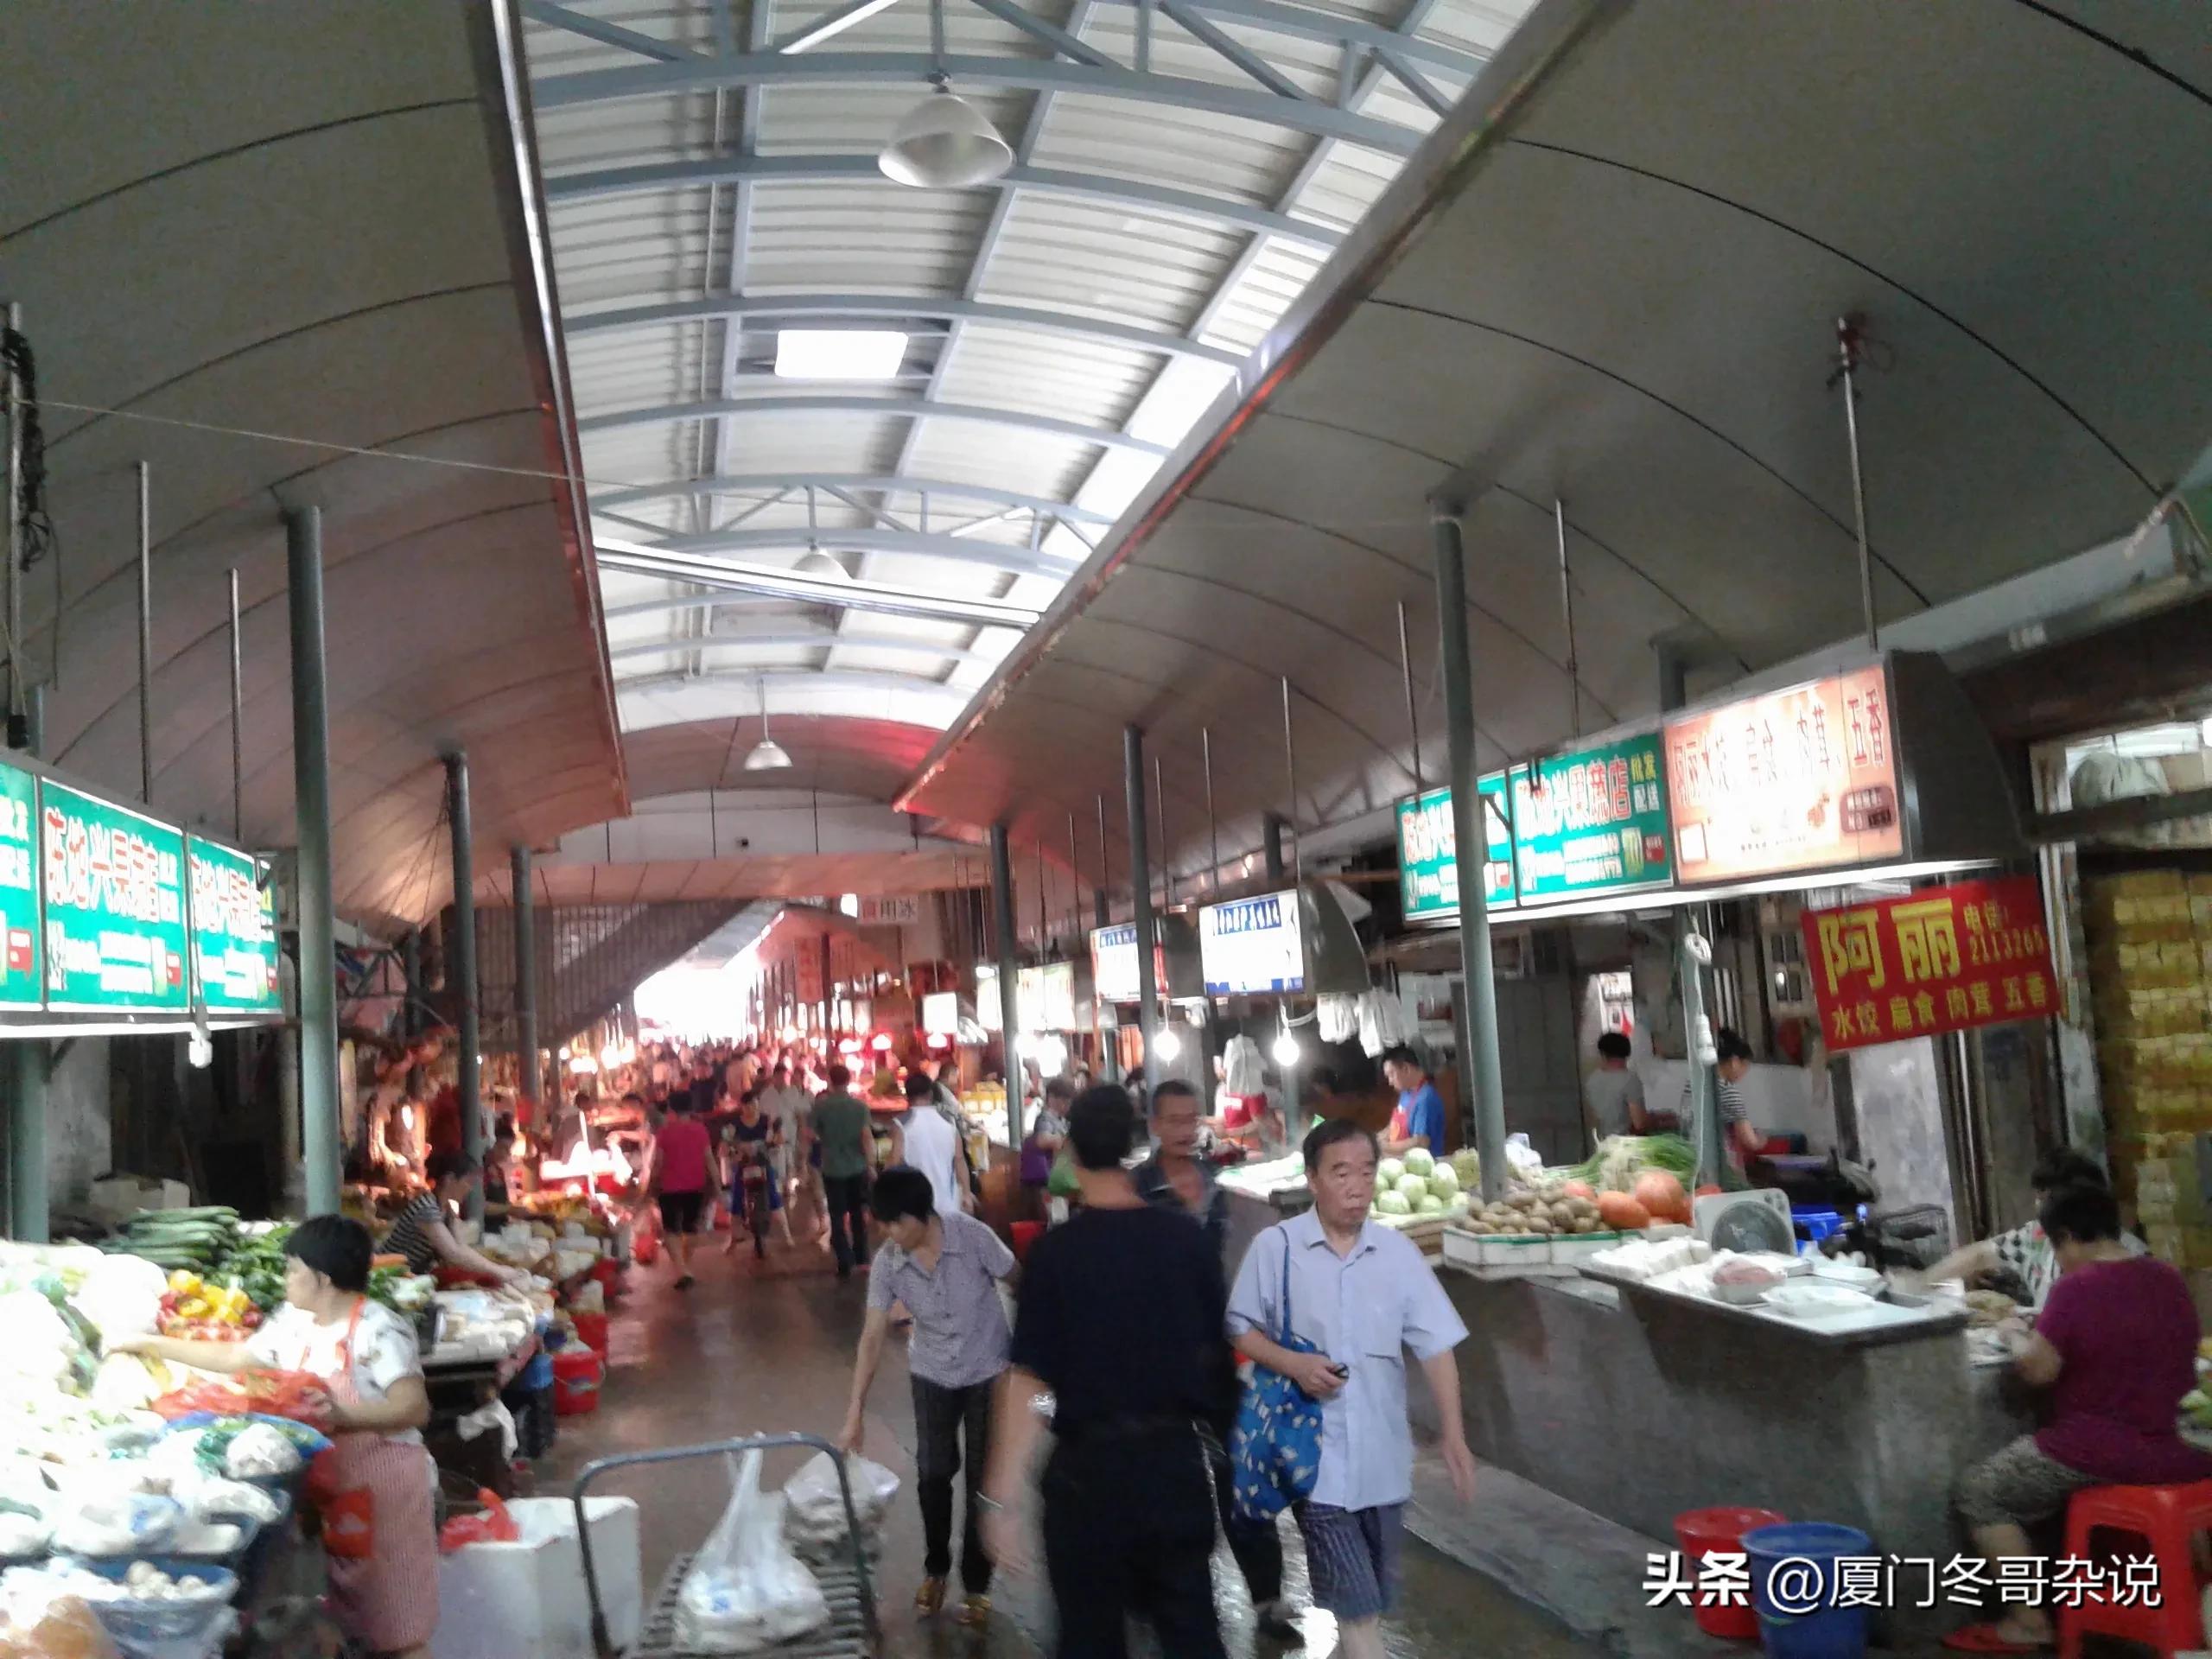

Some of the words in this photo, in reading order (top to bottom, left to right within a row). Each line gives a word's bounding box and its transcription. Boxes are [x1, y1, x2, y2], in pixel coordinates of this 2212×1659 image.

[1816, 897, 1962, 996] 阿丽
[1831, 999, 1881, 1040] 水饺
[2002, 971, 2049, 1013] 五香
